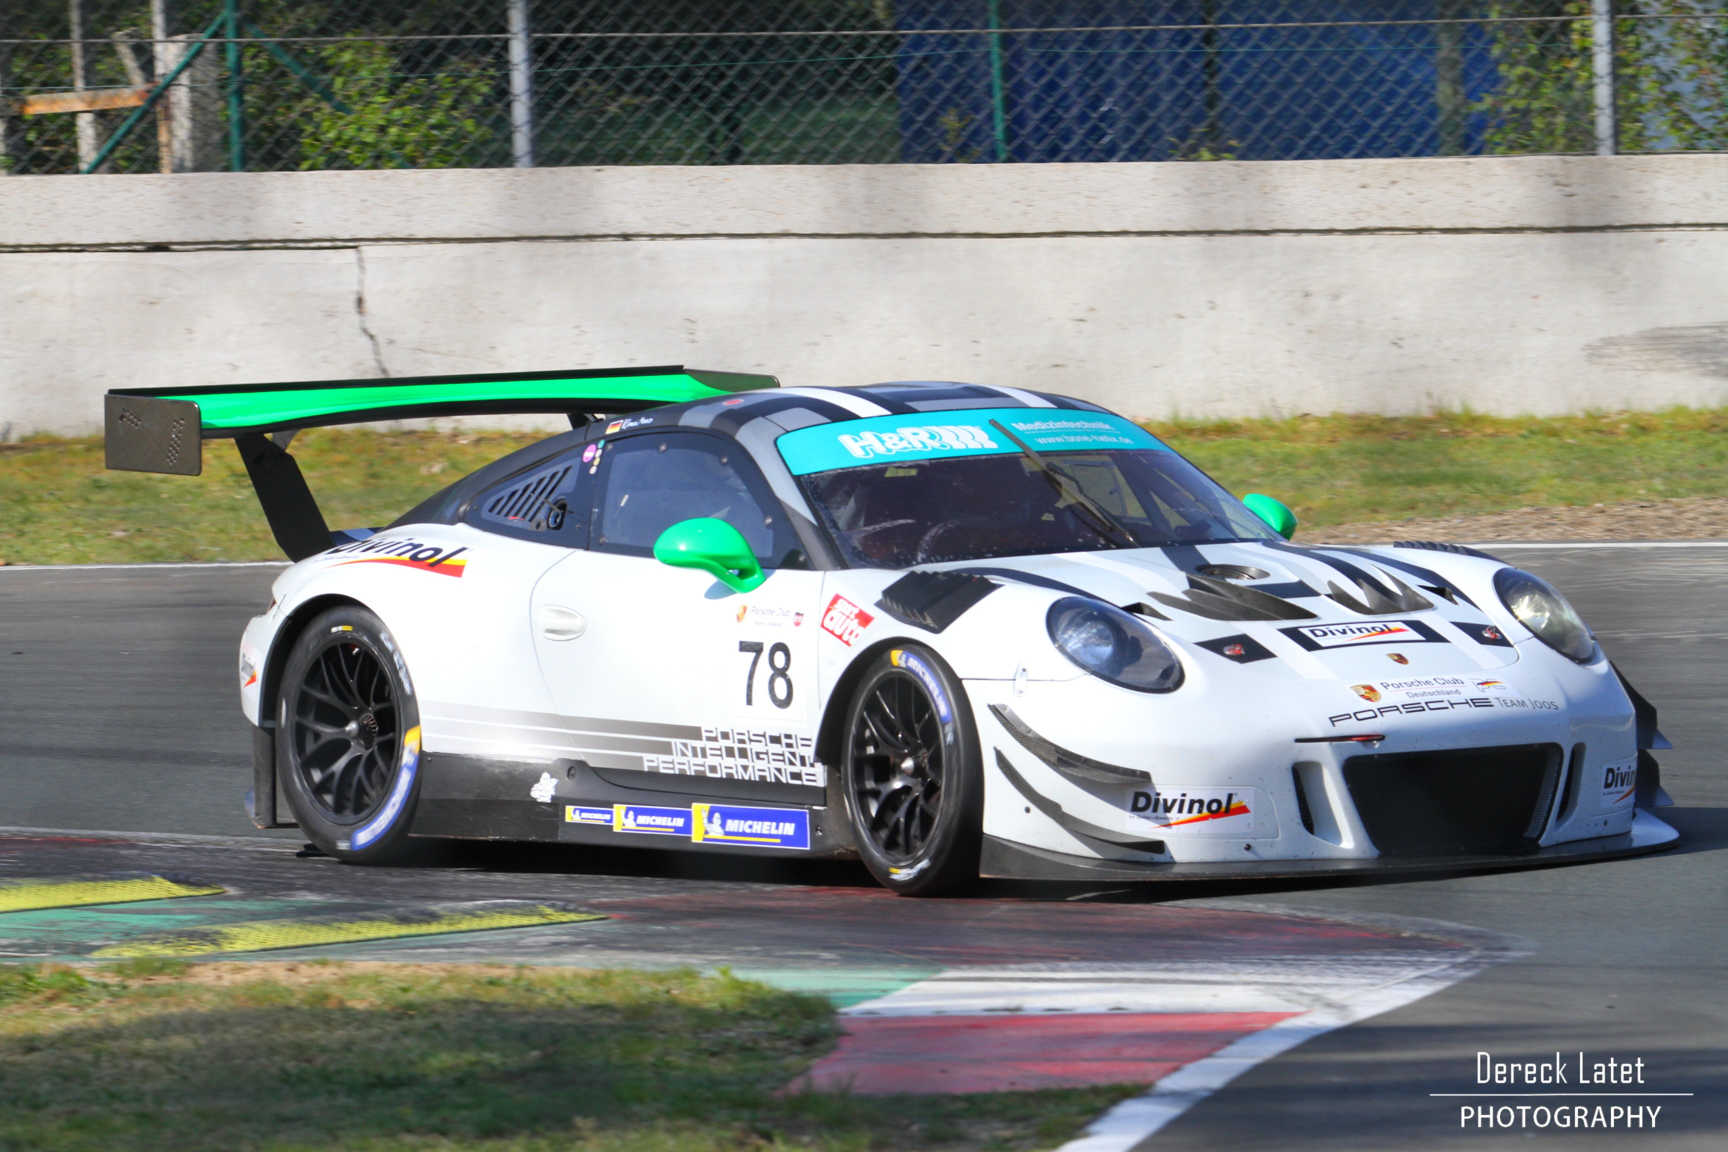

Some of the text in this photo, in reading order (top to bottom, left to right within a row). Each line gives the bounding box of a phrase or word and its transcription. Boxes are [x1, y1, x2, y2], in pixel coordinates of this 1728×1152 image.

[1309, 623, 1393, 638] Divinol
[739, 641, 793, 709] 78
[1379, 677, 1465, 690] Porsche Club
[1328, 697, 1494, 728] PORSCHE
[701, 727, 813, 750] PORSCHE
[672, 741, 816, 769] INTELLIGENT
[642, 755, 819, 786] PERFORMANCE
[1130, 791, 1235, 815] Divinol
[636, 815, 684, 828] MICHELIN
[725, 819, 796, 835] MICHELIN
